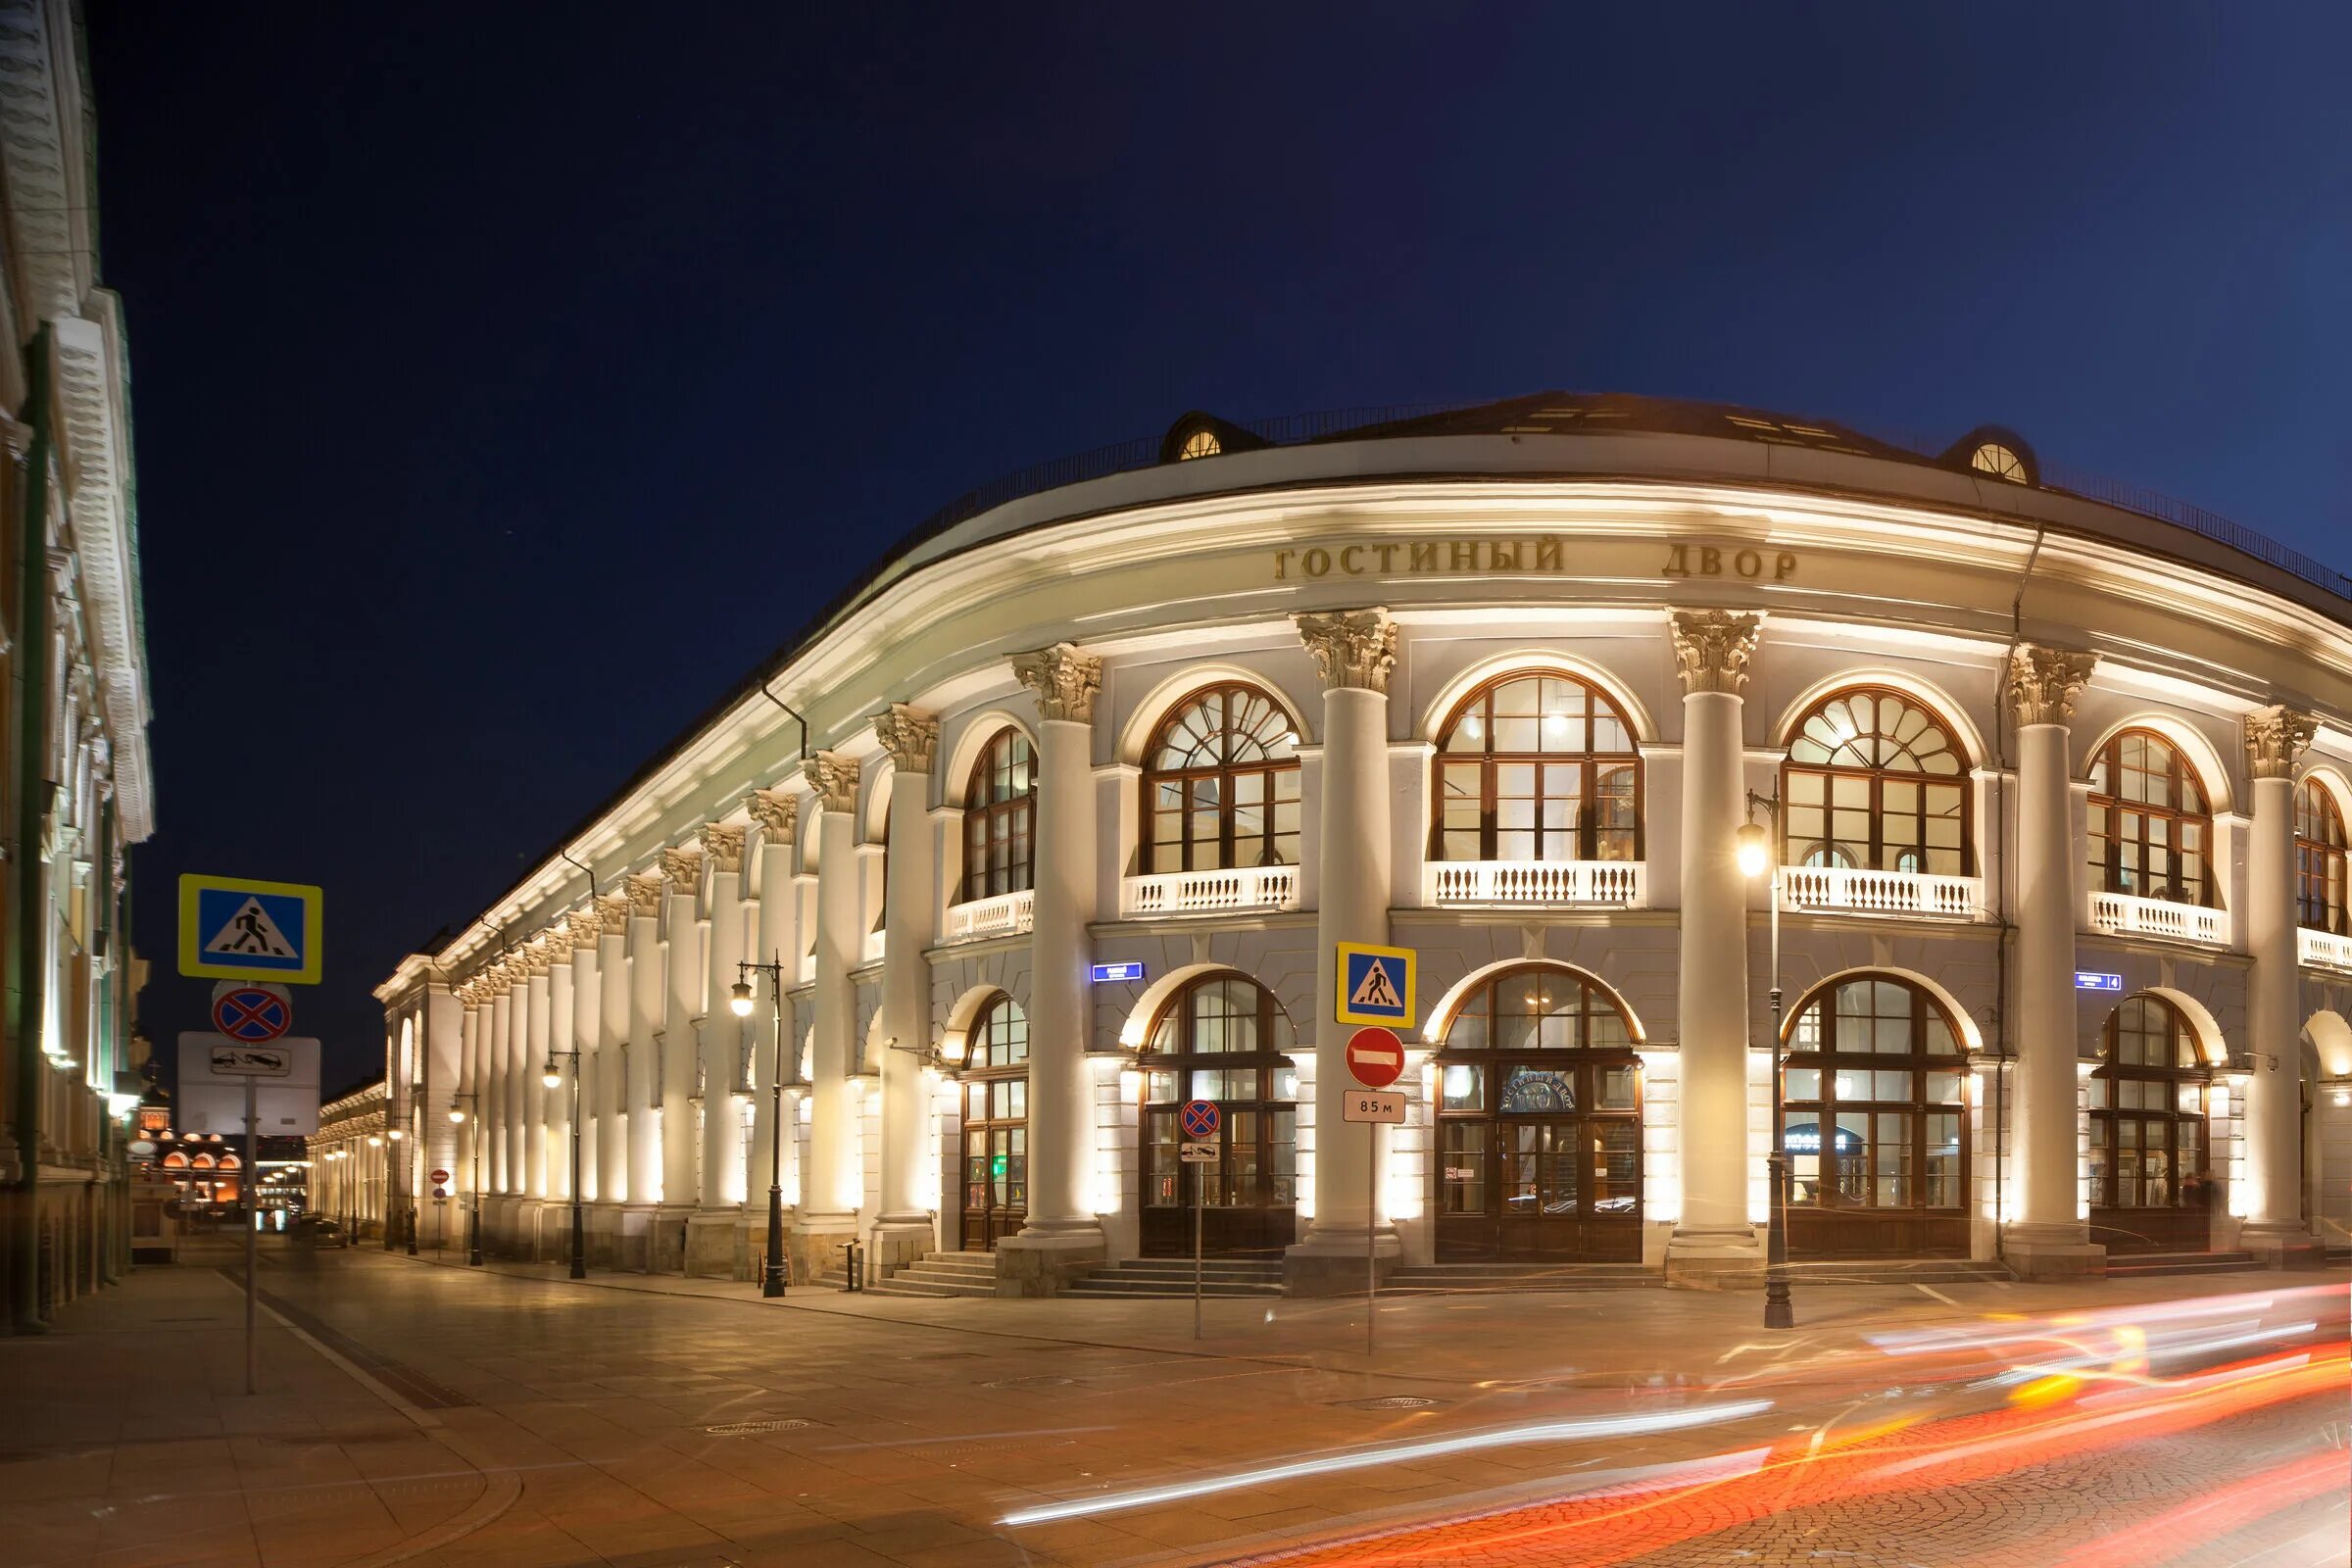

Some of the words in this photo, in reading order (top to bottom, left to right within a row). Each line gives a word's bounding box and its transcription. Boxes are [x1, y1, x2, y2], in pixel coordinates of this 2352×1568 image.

[1274, 534, 1564, 579] ГОСТИНЫЙ
[1661, 543, 1797, 579] ДВОР
[2111, 977, 2119, 988] 4
[1360, 1101, 1378, 1113] 85
